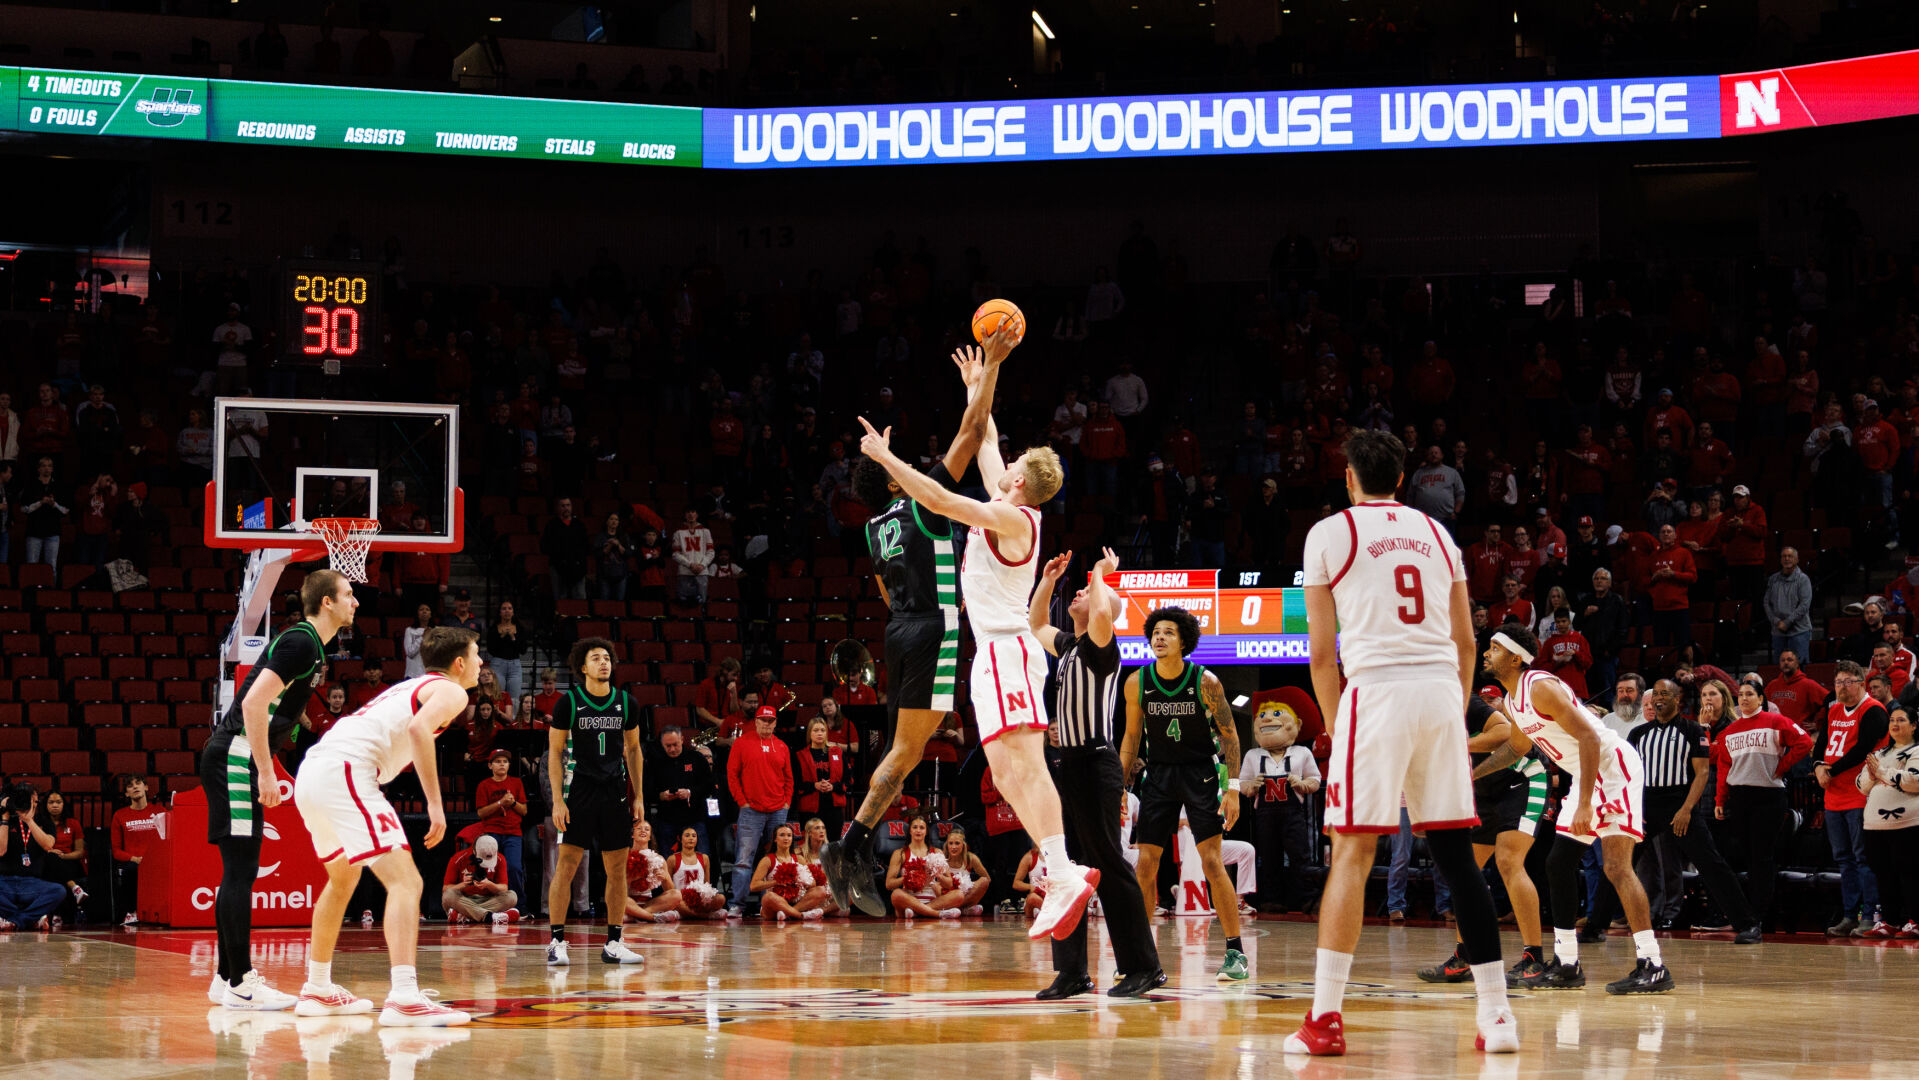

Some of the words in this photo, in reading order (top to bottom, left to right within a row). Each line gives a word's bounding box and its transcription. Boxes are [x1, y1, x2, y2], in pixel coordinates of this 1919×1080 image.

[28, 75, 40, 92] 4
[45, 76, 122, 97] TIMEOUTS
[135, 99, 202, 115] Spartans
[1381, 82, 1689, 143] WOODHOUSE
[1735, 77, 1781, 129] N
[30, 107, 43, 124] 0
[46, 108, 98, 126] FOULS
[1053, 95, 1353, 154] WOODHOUSE
[237, 121, 316, 140] REBOUNDS
[344, 127, 406, 145] ASSISTS
[435, 132, 518, 151] TURNOVERS
[734, 106, 1026, 163] WOODHOUSE
[544, 138, 596, 156] STEALS
[623, 143, 676, 160] BLOCKS
[172, 200, 233, 224] 112
[737, 226, 795, 249] 113
[294, 275, 367, 304] 20:00
[304, 306, 359, 355] 30
[1386, 512, 1398, 522] N
[685, 536, 700, 552] N
[878, 517, 904, 562] 12
[1366, 536, 1432, 558] BÜYÜKTUNCEL
[1119, 573, 1189, 589] NEBRASKA
[1239, 571, 1262, 586] 1ST
[1147, 598, 1157, 611] 4
[1394, 565, 1425, 624] 9
[1240, 595, 1262, 626] 0
[1236, 640, 1310, 658] WOODHOU
[1006, 691, 1027, 711] N
[1147, 701, 1196, 716] UPSTATE
[579, 716, 623, 730] UPSTATE
[1166, 717, 1181, 742] 4
[598, 731, 606, 756] 1
[1825, 730, 1849, 757] 51
[1264, 777, 1289, 803] N
[1327, 783, 1341, 807] N
[377, 812, 399, 832] N
[888, 821, 905, 836] N
[191, 885, 313, 911] Cnnel
[1184, 881, 1210, 911] N
